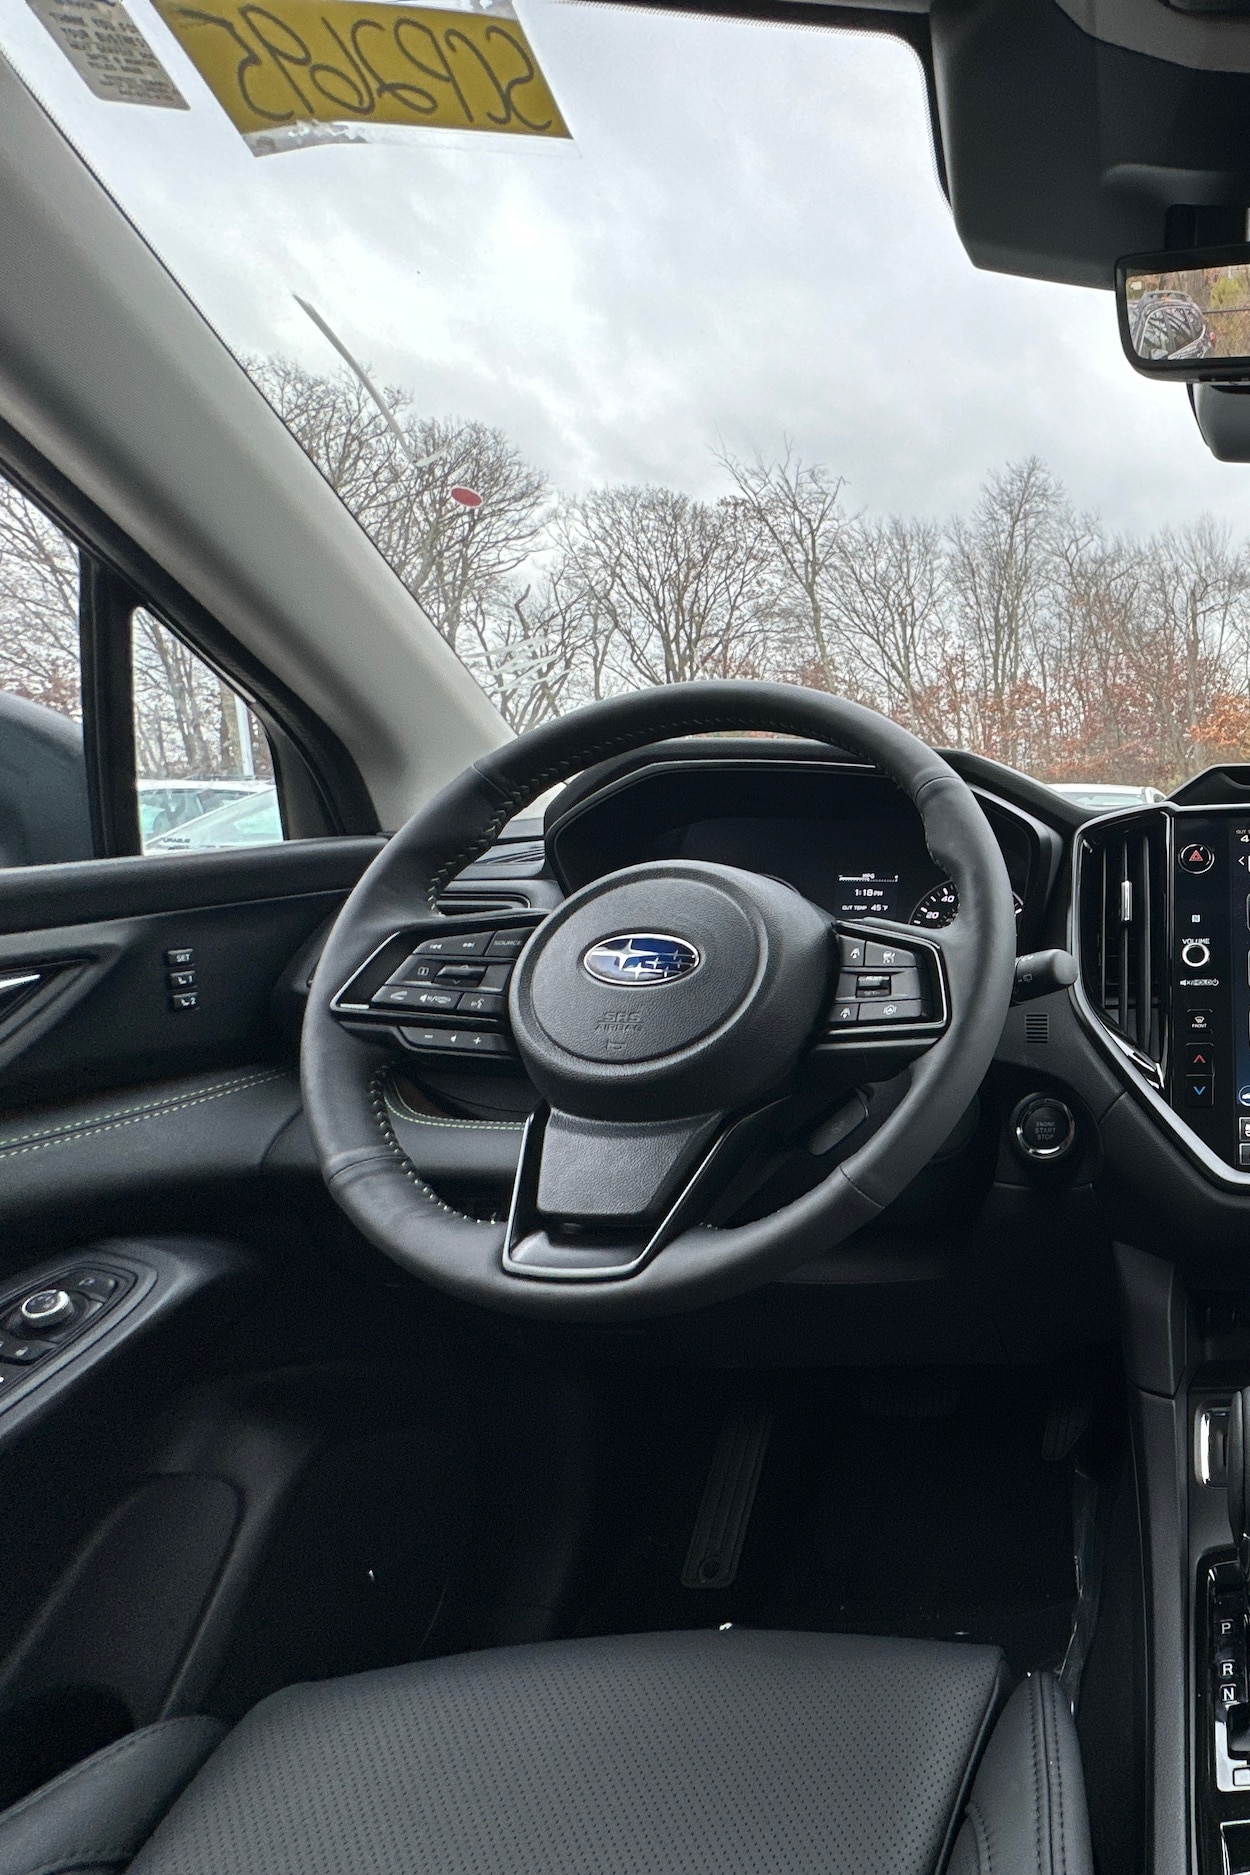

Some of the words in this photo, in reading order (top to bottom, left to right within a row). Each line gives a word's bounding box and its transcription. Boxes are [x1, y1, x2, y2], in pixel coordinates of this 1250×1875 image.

[941, 895, 955, 903] 40
[926, 911, 940, 919] 20
[603, 1011, 642, 1023] SRS
[1221, 1622, 1232, 1635] P
[1222, 1663, 1234, 1676] R
[1223, 1691, 1235, 1701] N
